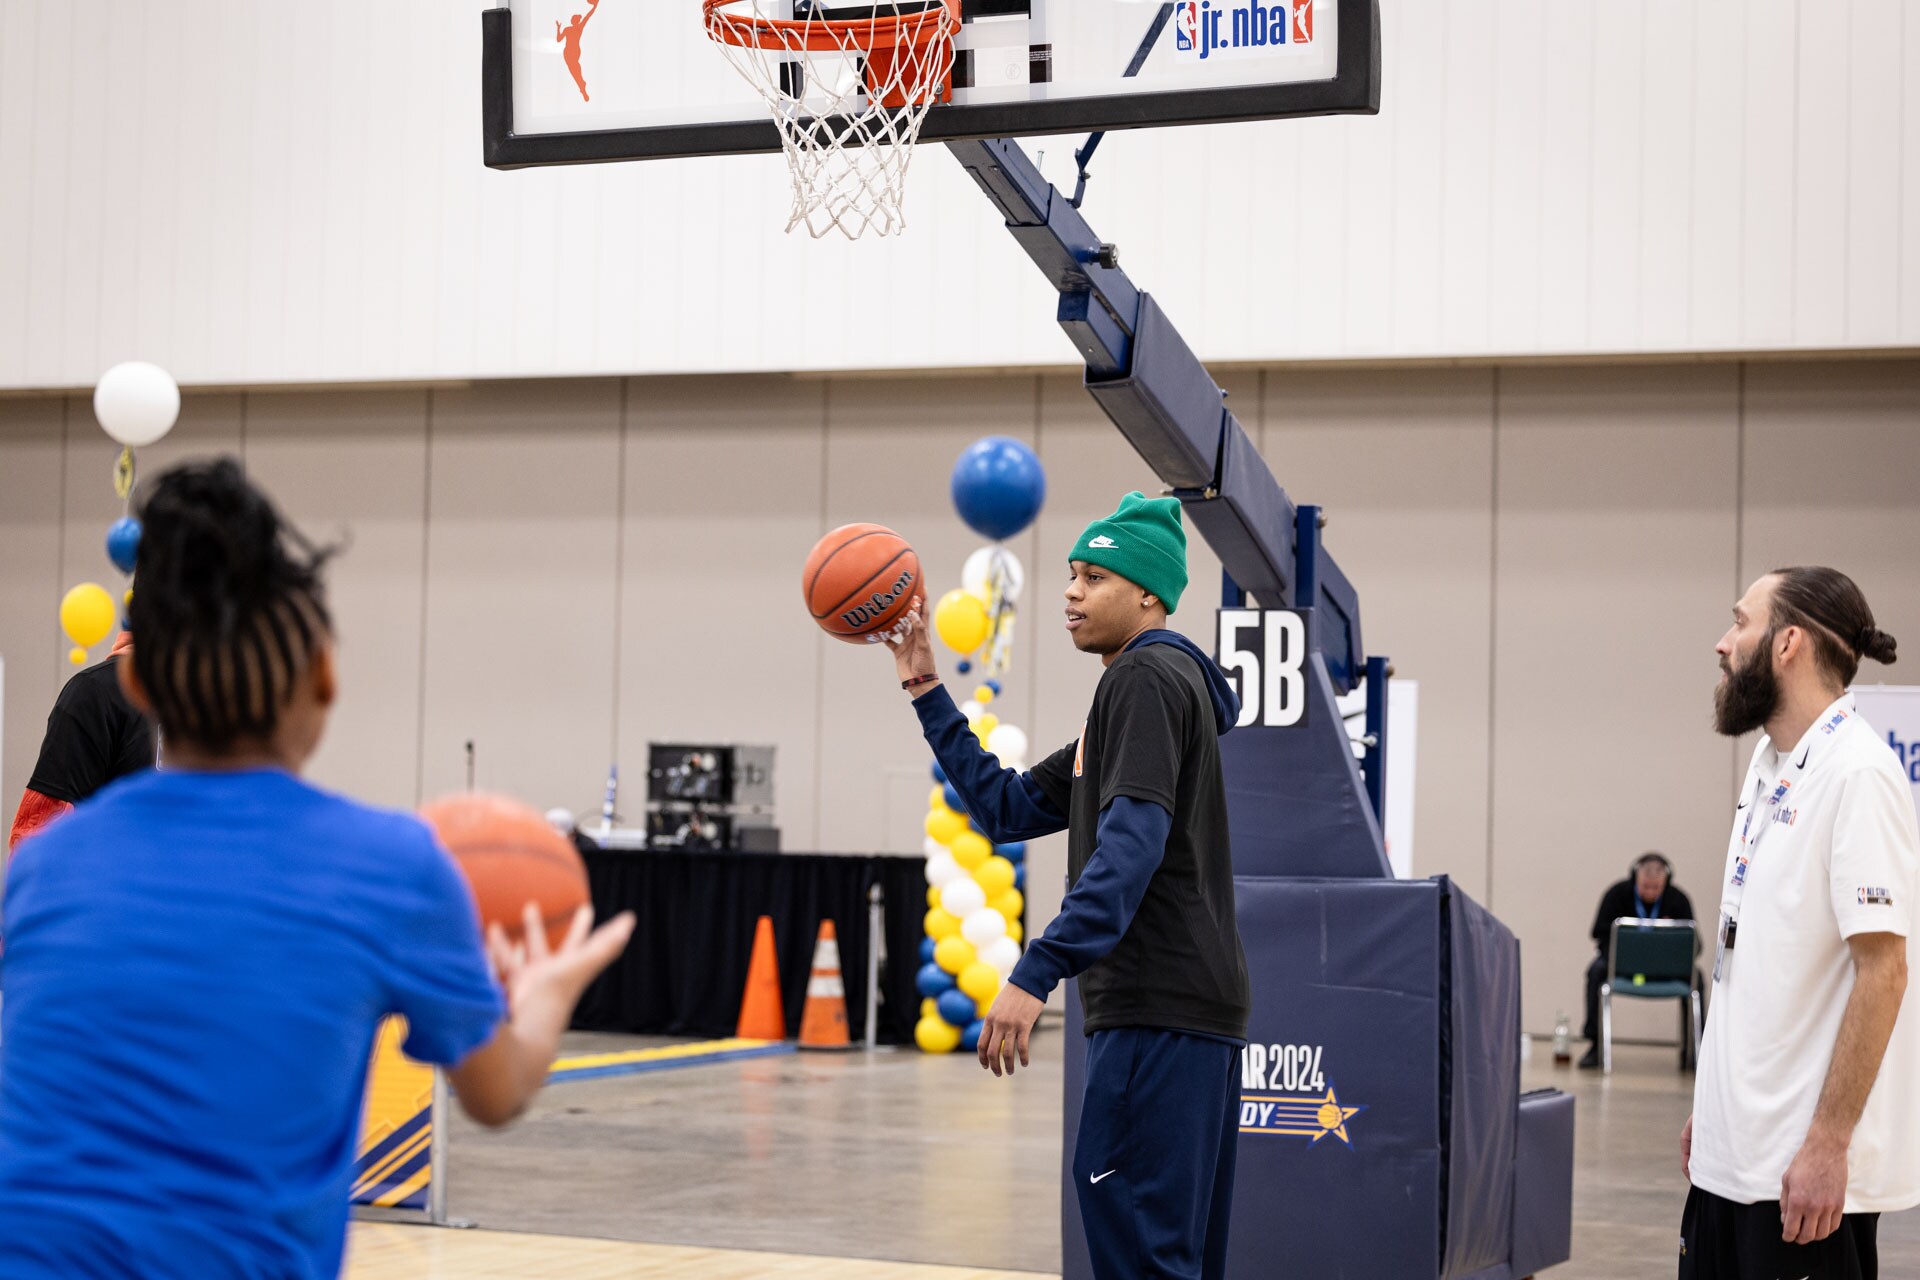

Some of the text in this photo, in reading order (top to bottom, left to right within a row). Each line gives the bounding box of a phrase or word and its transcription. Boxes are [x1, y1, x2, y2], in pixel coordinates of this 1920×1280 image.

[840, 570, 914, 628] Wilson
[1219, 610, 1306, 728] 5B
[1268, 1043, 1326, 1092] 2024
[1239, 1102, 1276, 1127] DY
